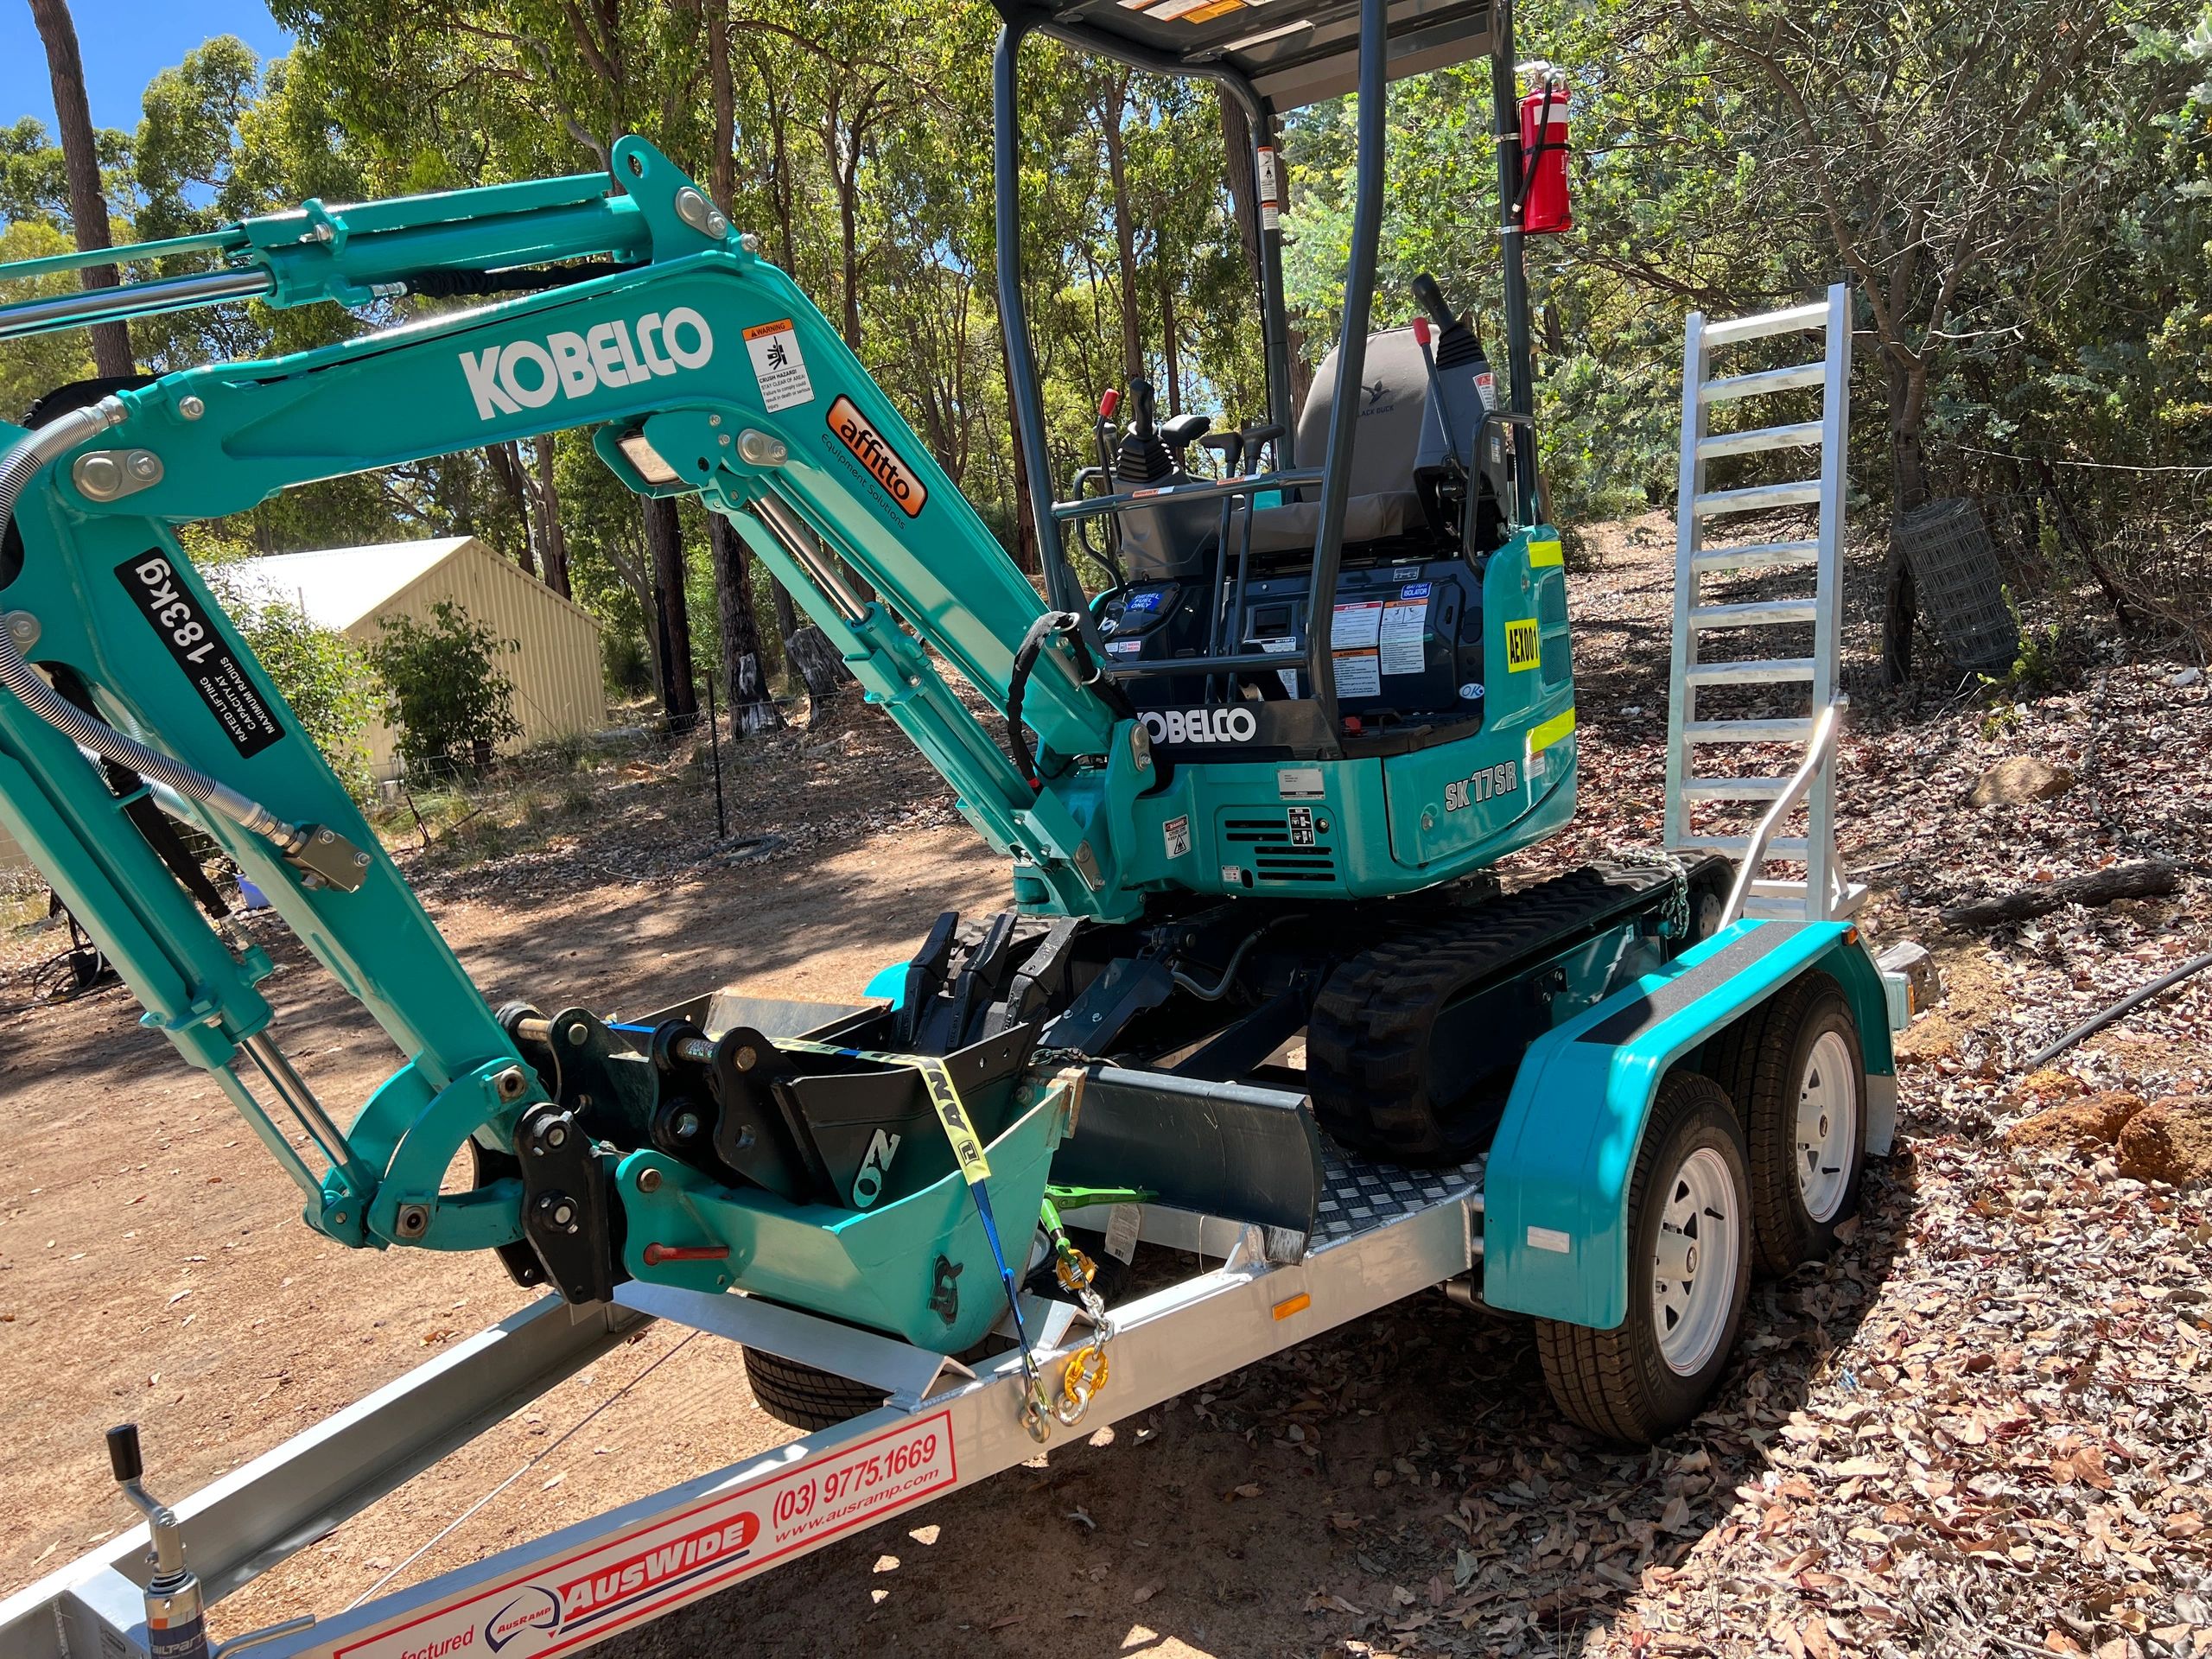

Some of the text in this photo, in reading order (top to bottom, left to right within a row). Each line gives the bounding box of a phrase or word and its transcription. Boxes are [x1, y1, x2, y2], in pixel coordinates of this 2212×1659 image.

[757, 322, 785, 335] WARNING
[459, 307, 713, 421] KOBELCO
[760, 369, 798, 384] CRUSH HAZARD!
[772, 378, 787, 387] CLEAR
[822, 433, 906, 530] Equipment Solutions
[840, 418, 910, 500] affitto
[136, 558, 215, 664] 183kg
[1403, 588, 1427, 596] ISOLATOR
[1510, 626, 1539, 664] AEX001
[200, 677, 249, 743] RATED LIFTING
[214, 675, 257, 731] CAPACITY AT
[219, 657, 276, 734] MAXIMUM RADIUS
[1462, 685, 1481, 697] OK
[1137, 708, 1256, 745] OBELCO
[1445, 778, 1471, 812] SK
[1471, 760, 1518, 803] 17SR
[772, 1433, 936, 1529] (03) 9775.1669
[775, 1469, 939, 1543] www.ausramp.com
